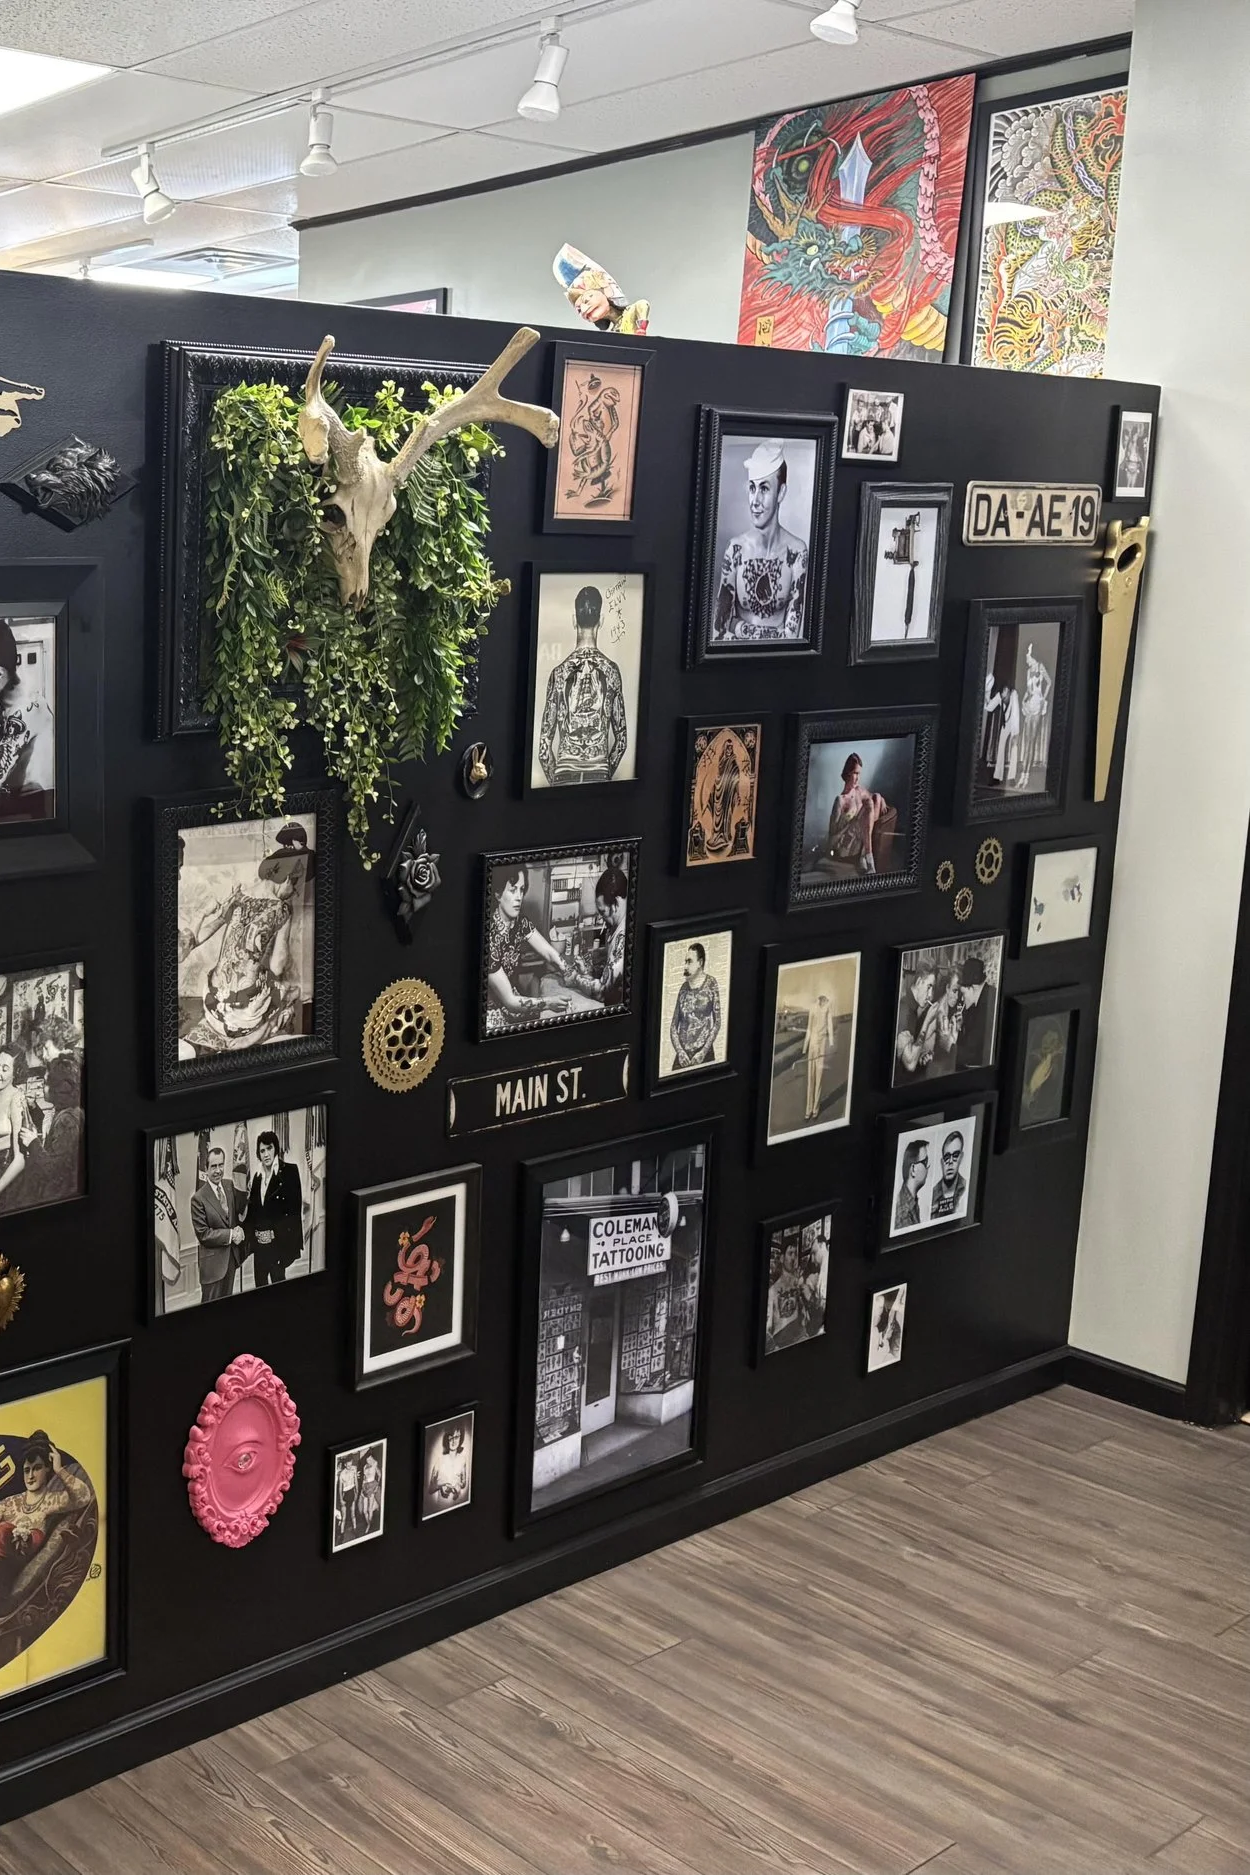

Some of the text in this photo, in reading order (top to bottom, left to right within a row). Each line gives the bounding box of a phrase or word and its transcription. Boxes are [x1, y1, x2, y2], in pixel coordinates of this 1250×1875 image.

[495, 1066, 587, 1117] MAIN ST.
[612, 1233, 653, 1247] PLACE
[592, 1242, 665, 1269] TATTOOING
